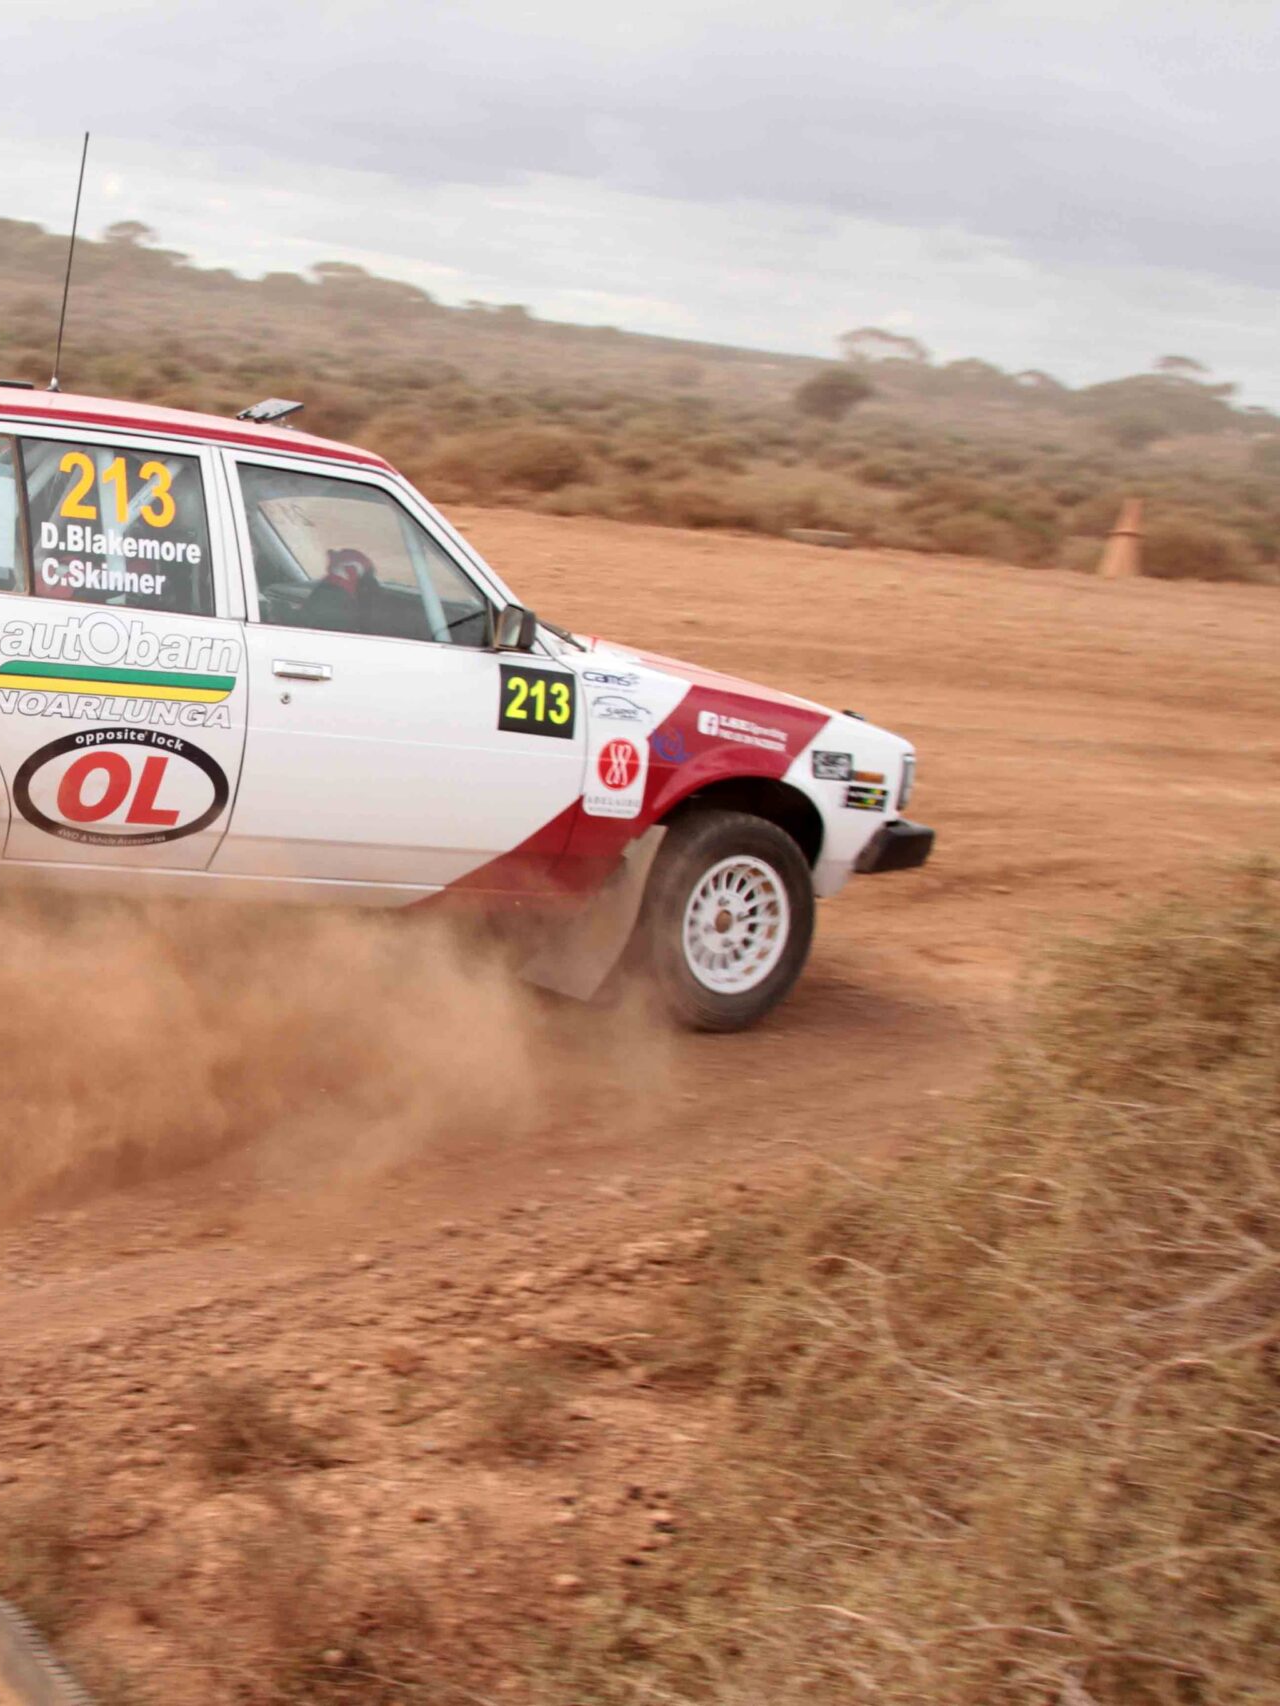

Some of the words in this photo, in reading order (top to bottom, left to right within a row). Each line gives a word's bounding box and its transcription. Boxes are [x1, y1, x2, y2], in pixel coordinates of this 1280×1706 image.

[59, 452, 176, 528] 213
[40, 521, 202, 565] D.Blakemore
[41, 557, 166, 595] C.Skinner
[505, 676, 572, 725] 213
[75, 727, 145, 745] opposite
[150, 730, 184, 751] lock
[56, 751, 181, 826] OL
